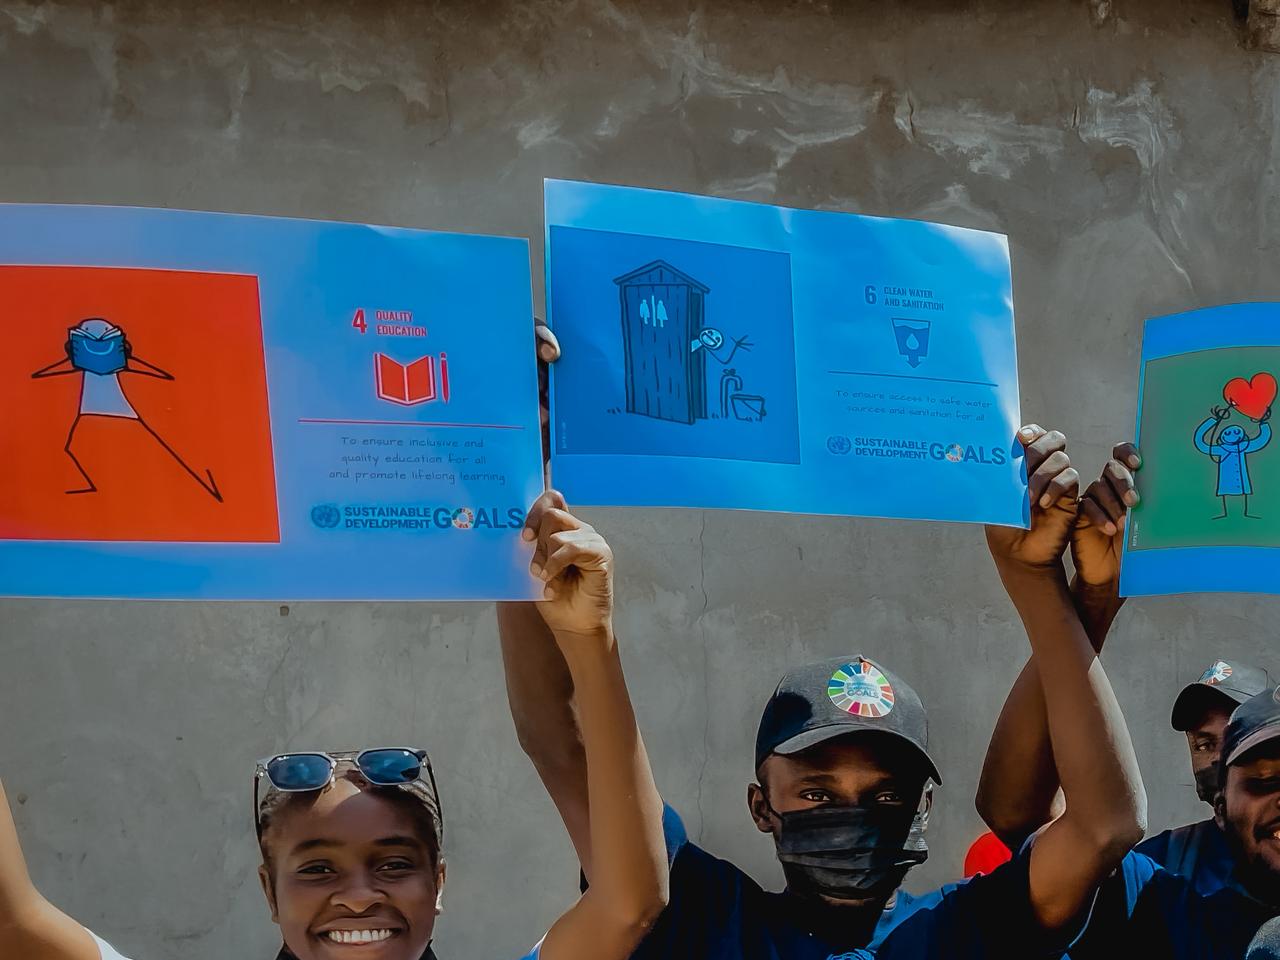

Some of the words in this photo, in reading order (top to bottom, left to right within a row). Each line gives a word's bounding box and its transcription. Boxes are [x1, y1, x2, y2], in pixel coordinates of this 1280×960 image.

[864, 285, 876, 305] 6
[884, 286, 907, 297] CLEAN
[909, 289, 933, 298] WATER
[902, 301, 944, 312] SANITATION
[352, 309, 367, 334] 4
[376, 311, 413, 322] QUALITY
[377, 325, 427, 337] EDUCATION
[889, 407, 905, 415] and
[342, 437, 357, 446] To
[362, 439, 404, 448] ensure
[409, 438, 458, 448] inclusive
[464, 439, 484, 448] and
[855, 437, 928, 450] SUSTAINABLE
[341, 454, 378, 465] quality
[385, 454, 442, 464] education
[448, 454, 468, 464] for
[474, 456, 486, 465] all
[855, 448, 928, 460] DEVELOPMENT
[930, 443, 1006, 465] GOALS
[329, 470, 349, 479] and
[355, 471, 407, 483] promote
[412, 471, 456, 484] lifelong
[460, 472, 506, 485] learning
[345, 506, 431, 518] SUSTAINABLE
[433, 507, 524, 529] GOALS
[345, 518, 430, 529] DEVELOPMENT
